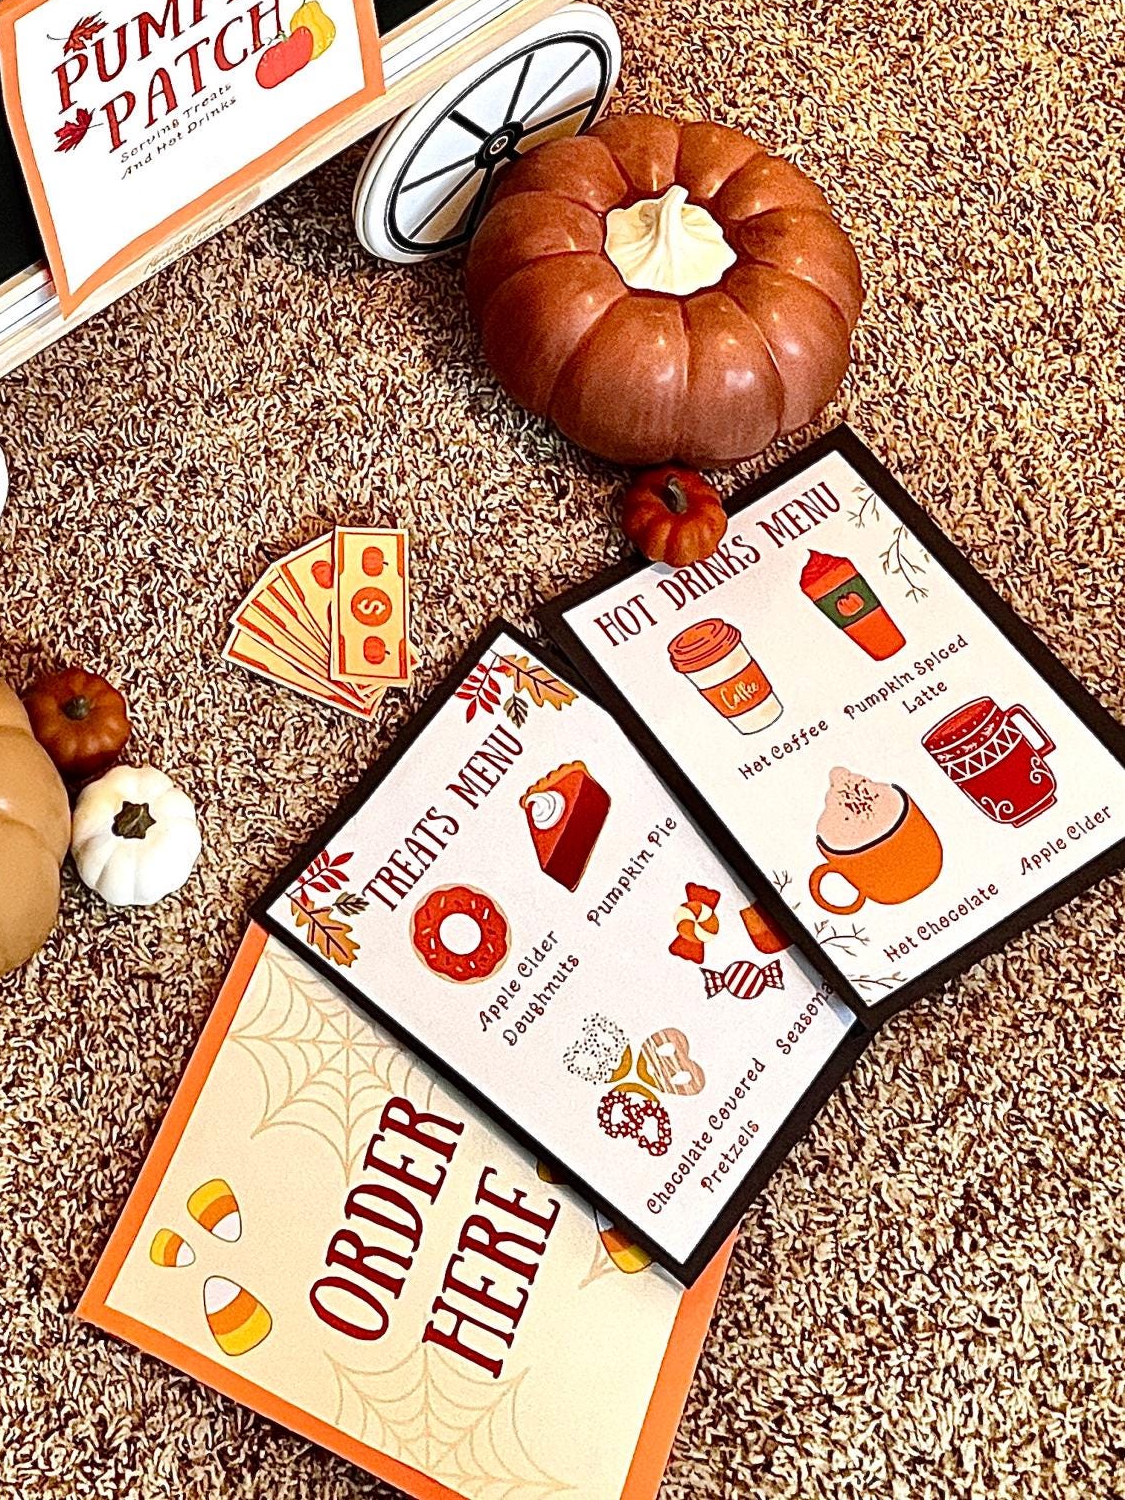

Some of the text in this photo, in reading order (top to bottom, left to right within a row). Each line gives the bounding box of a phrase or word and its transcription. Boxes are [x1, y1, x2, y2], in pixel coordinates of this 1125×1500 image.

[121, 83, 232, 163] Serving Treats
[121, 96, 236, 180] And Hot Drinks
[593, 481, 841, 647] HOT DRINKS MENU
[843, 634, 968, 720] Pumpkin Spiced
[902, 679, 948, 714] Latte
[738, 719, 829, 780] Hot Coffee
[361, 723, 523, 912] TREATS MENU
[1020, 805, 1112, 876] Apple Cider
[586, 817, 677, 927] Pumpkin Pie
[883, 883, 999, 963] Hot Chocolate
[479, 930, 558, 1032] Apple Cider
[502, 955, 579, 1046] Doughnuts
[646, 980, 834, 1214] Chocolate Covered Seasona
[700, 1120, 759, 1193] Pretzels
[308, 1095, 465, 1342] ORDER
[422, 1166, 561, 1379] HERE
